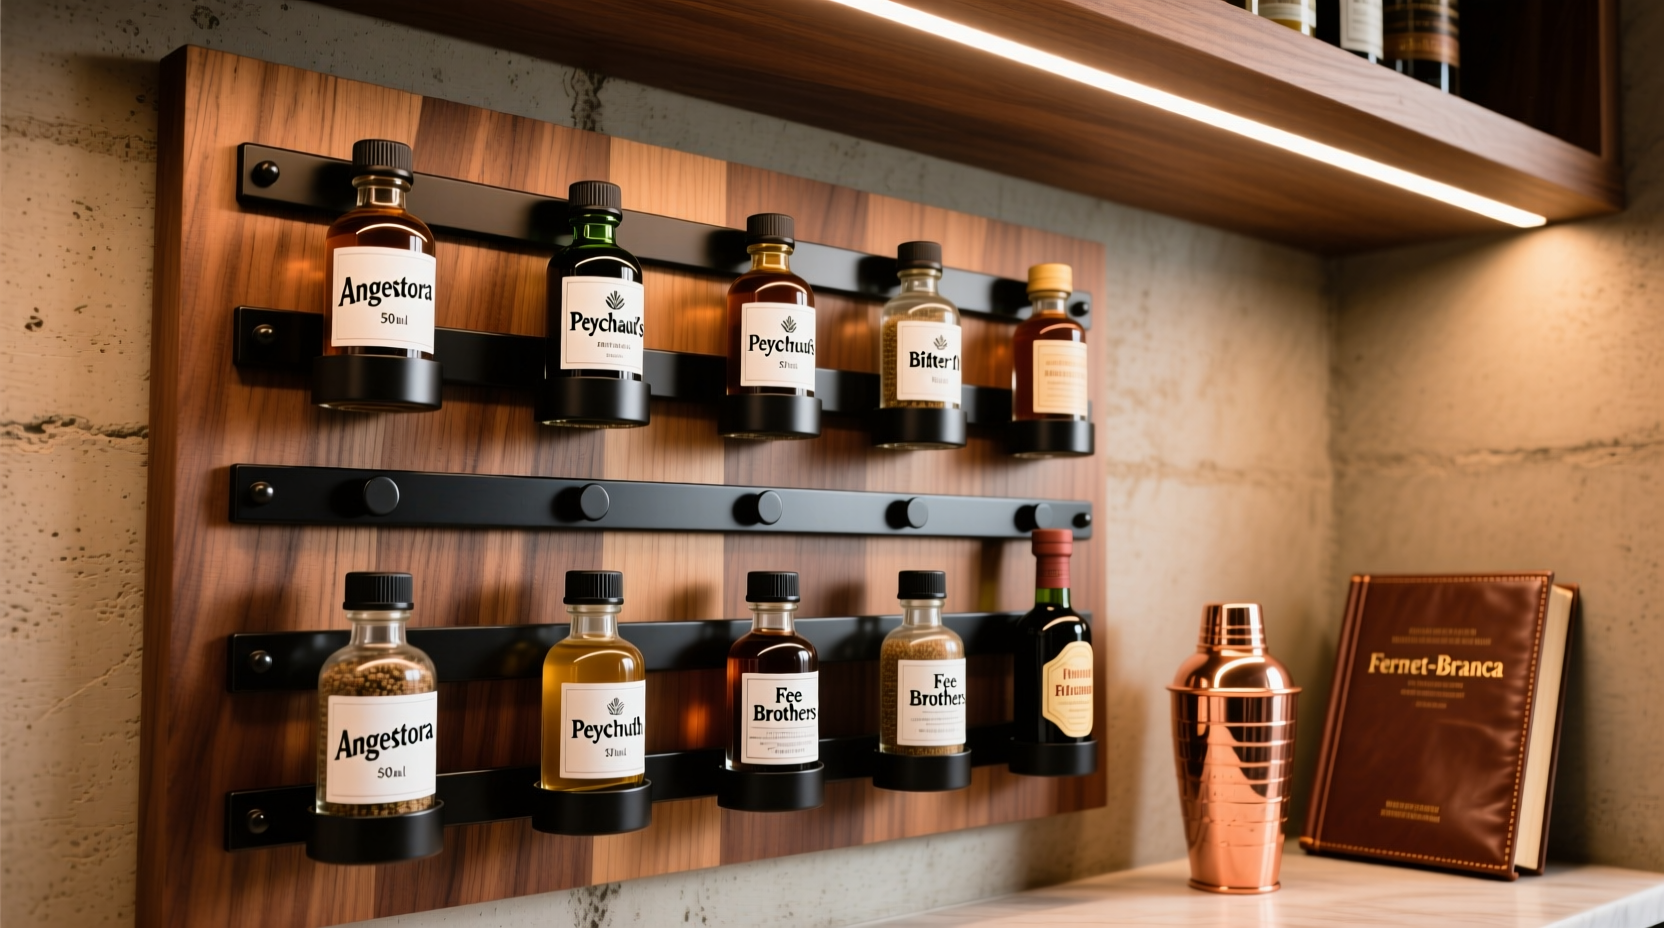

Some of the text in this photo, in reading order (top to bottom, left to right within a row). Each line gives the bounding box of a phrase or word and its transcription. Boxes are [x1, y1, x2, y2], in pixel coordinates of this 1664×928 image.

[338, 276, 432, 307] Angestora
[1368, 652, 1504, 678] Fernet-Branca
[933, 673, 957, 689] Fee
[775, 686, 803, 703] Fee
[753, 702, 817, 722] Brothers
[334, 722, 433, 762] Angestora
